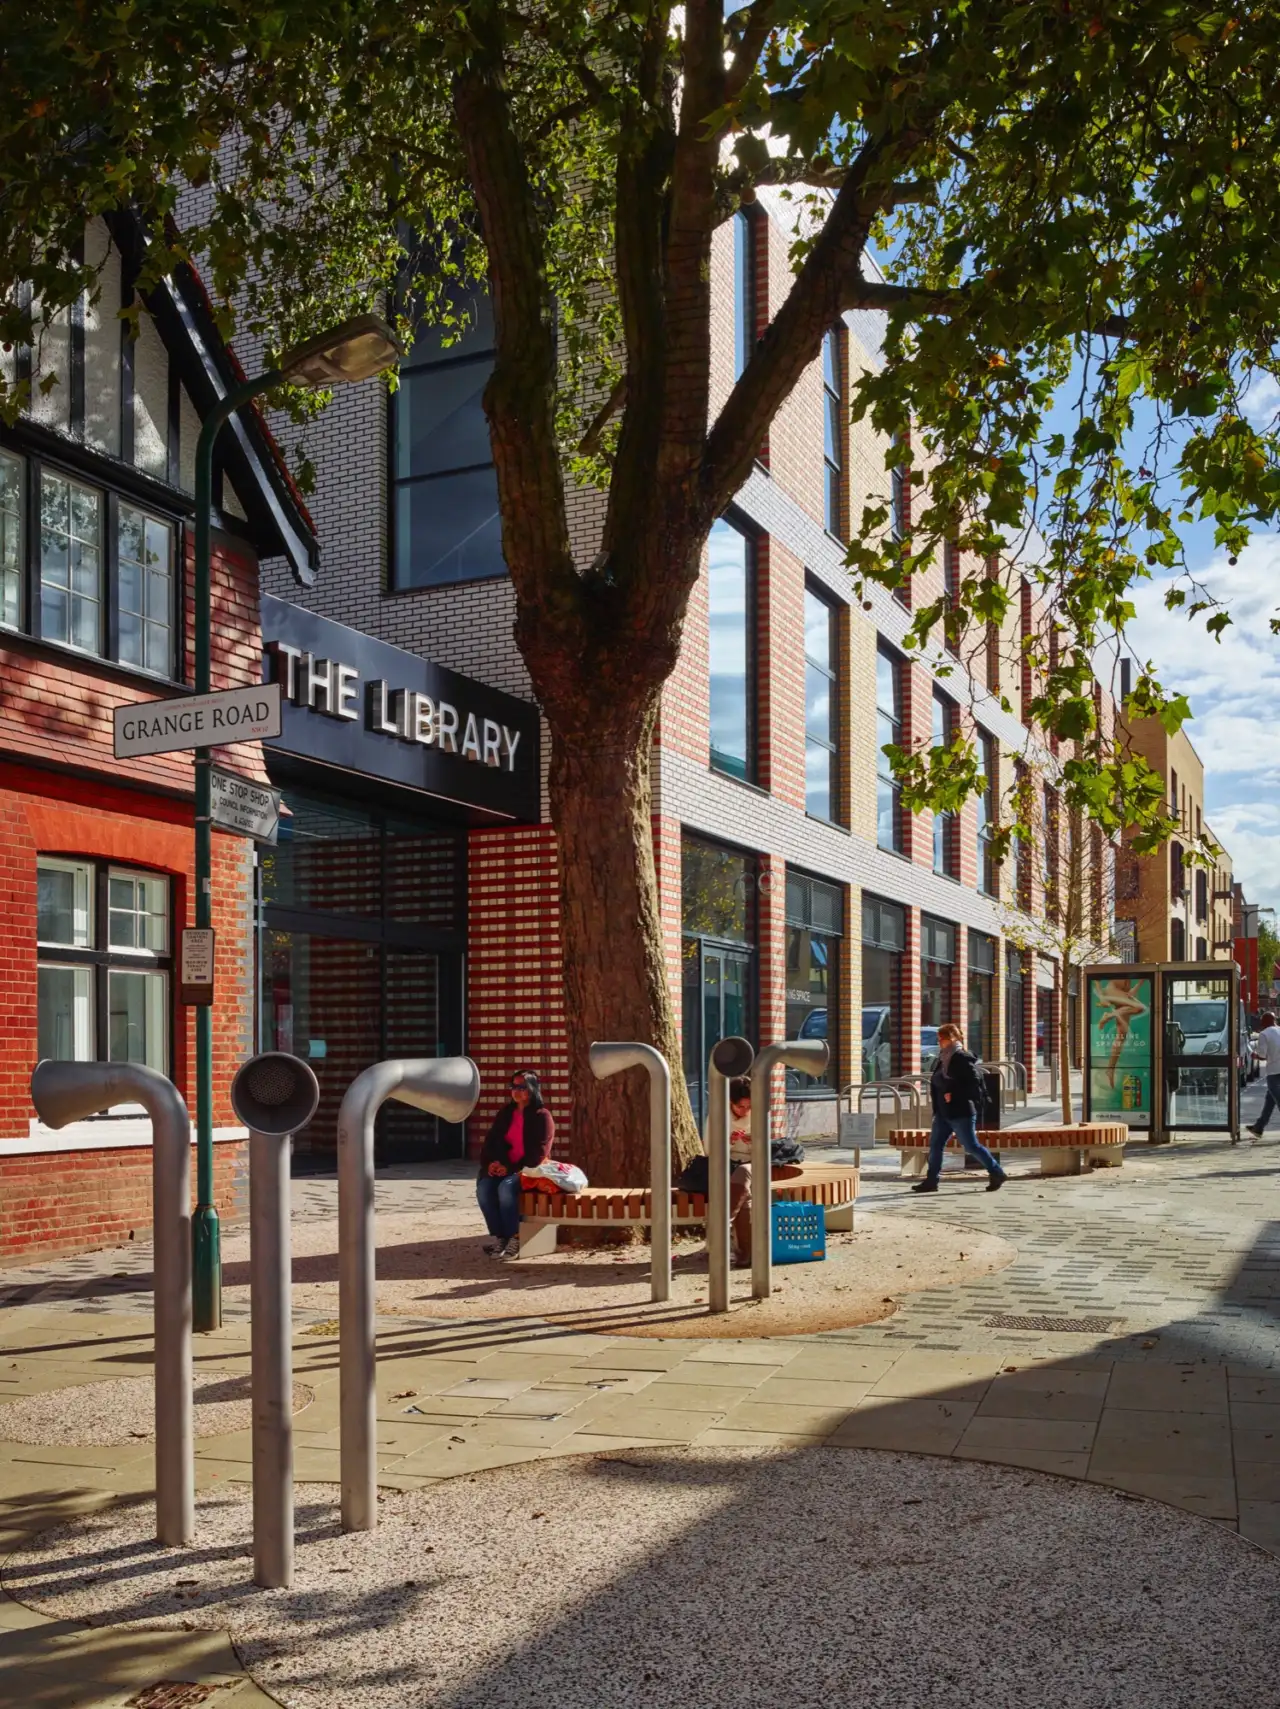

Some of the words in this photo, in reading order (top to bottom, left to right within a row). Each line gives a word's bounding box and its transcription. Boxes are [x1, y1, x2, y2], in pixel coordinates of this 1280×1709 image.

[122, 711, 205, 741] GRANGE
[212, 701, 270, 729] ROAD
[276, 641, 360, 721] THE
[376, 678, 521, 772] LIBRARY
[211, 774, 227, 793] ONE
[229, 782, 249, 800] STOP
[250, 789, 270, 807] SHOP
[219, 796, 239, 811] COUNCIL
[239, 803, 268, 821] INFORMATION
[796, 989, 811, 1003] SPACE
